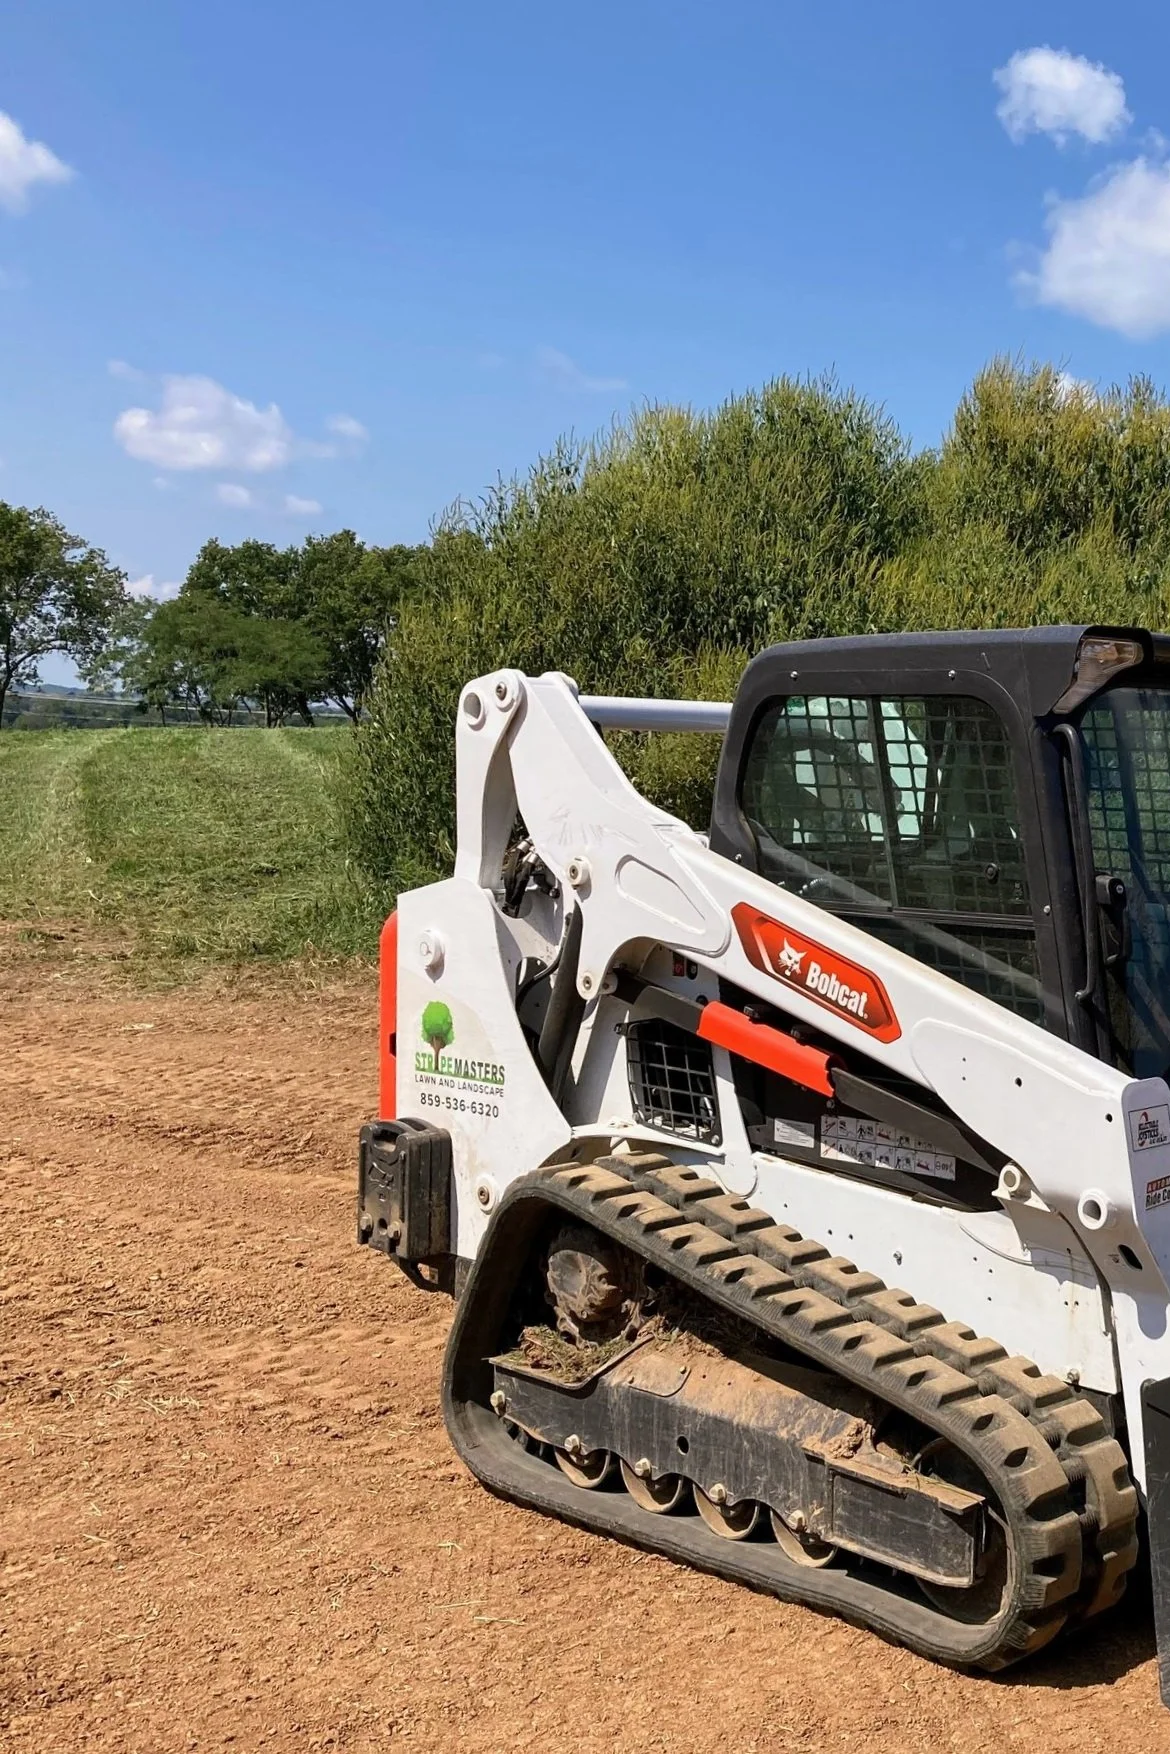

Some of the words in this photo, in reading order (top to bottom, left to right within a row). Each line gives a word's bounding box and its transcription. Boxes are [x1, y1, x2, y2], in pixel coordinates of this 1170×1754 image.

[805, 961, 869, 1018] Bobcat
[415, 1074, 436, 1085] LAWN
[438, 1078, 455, 1088] AND
[457, 1080, 504, 1097] LANDSCAPE
[420, 1093, 499, 1118] 859-536-6320
[1146, 1192, 1161, 1208] Ride
